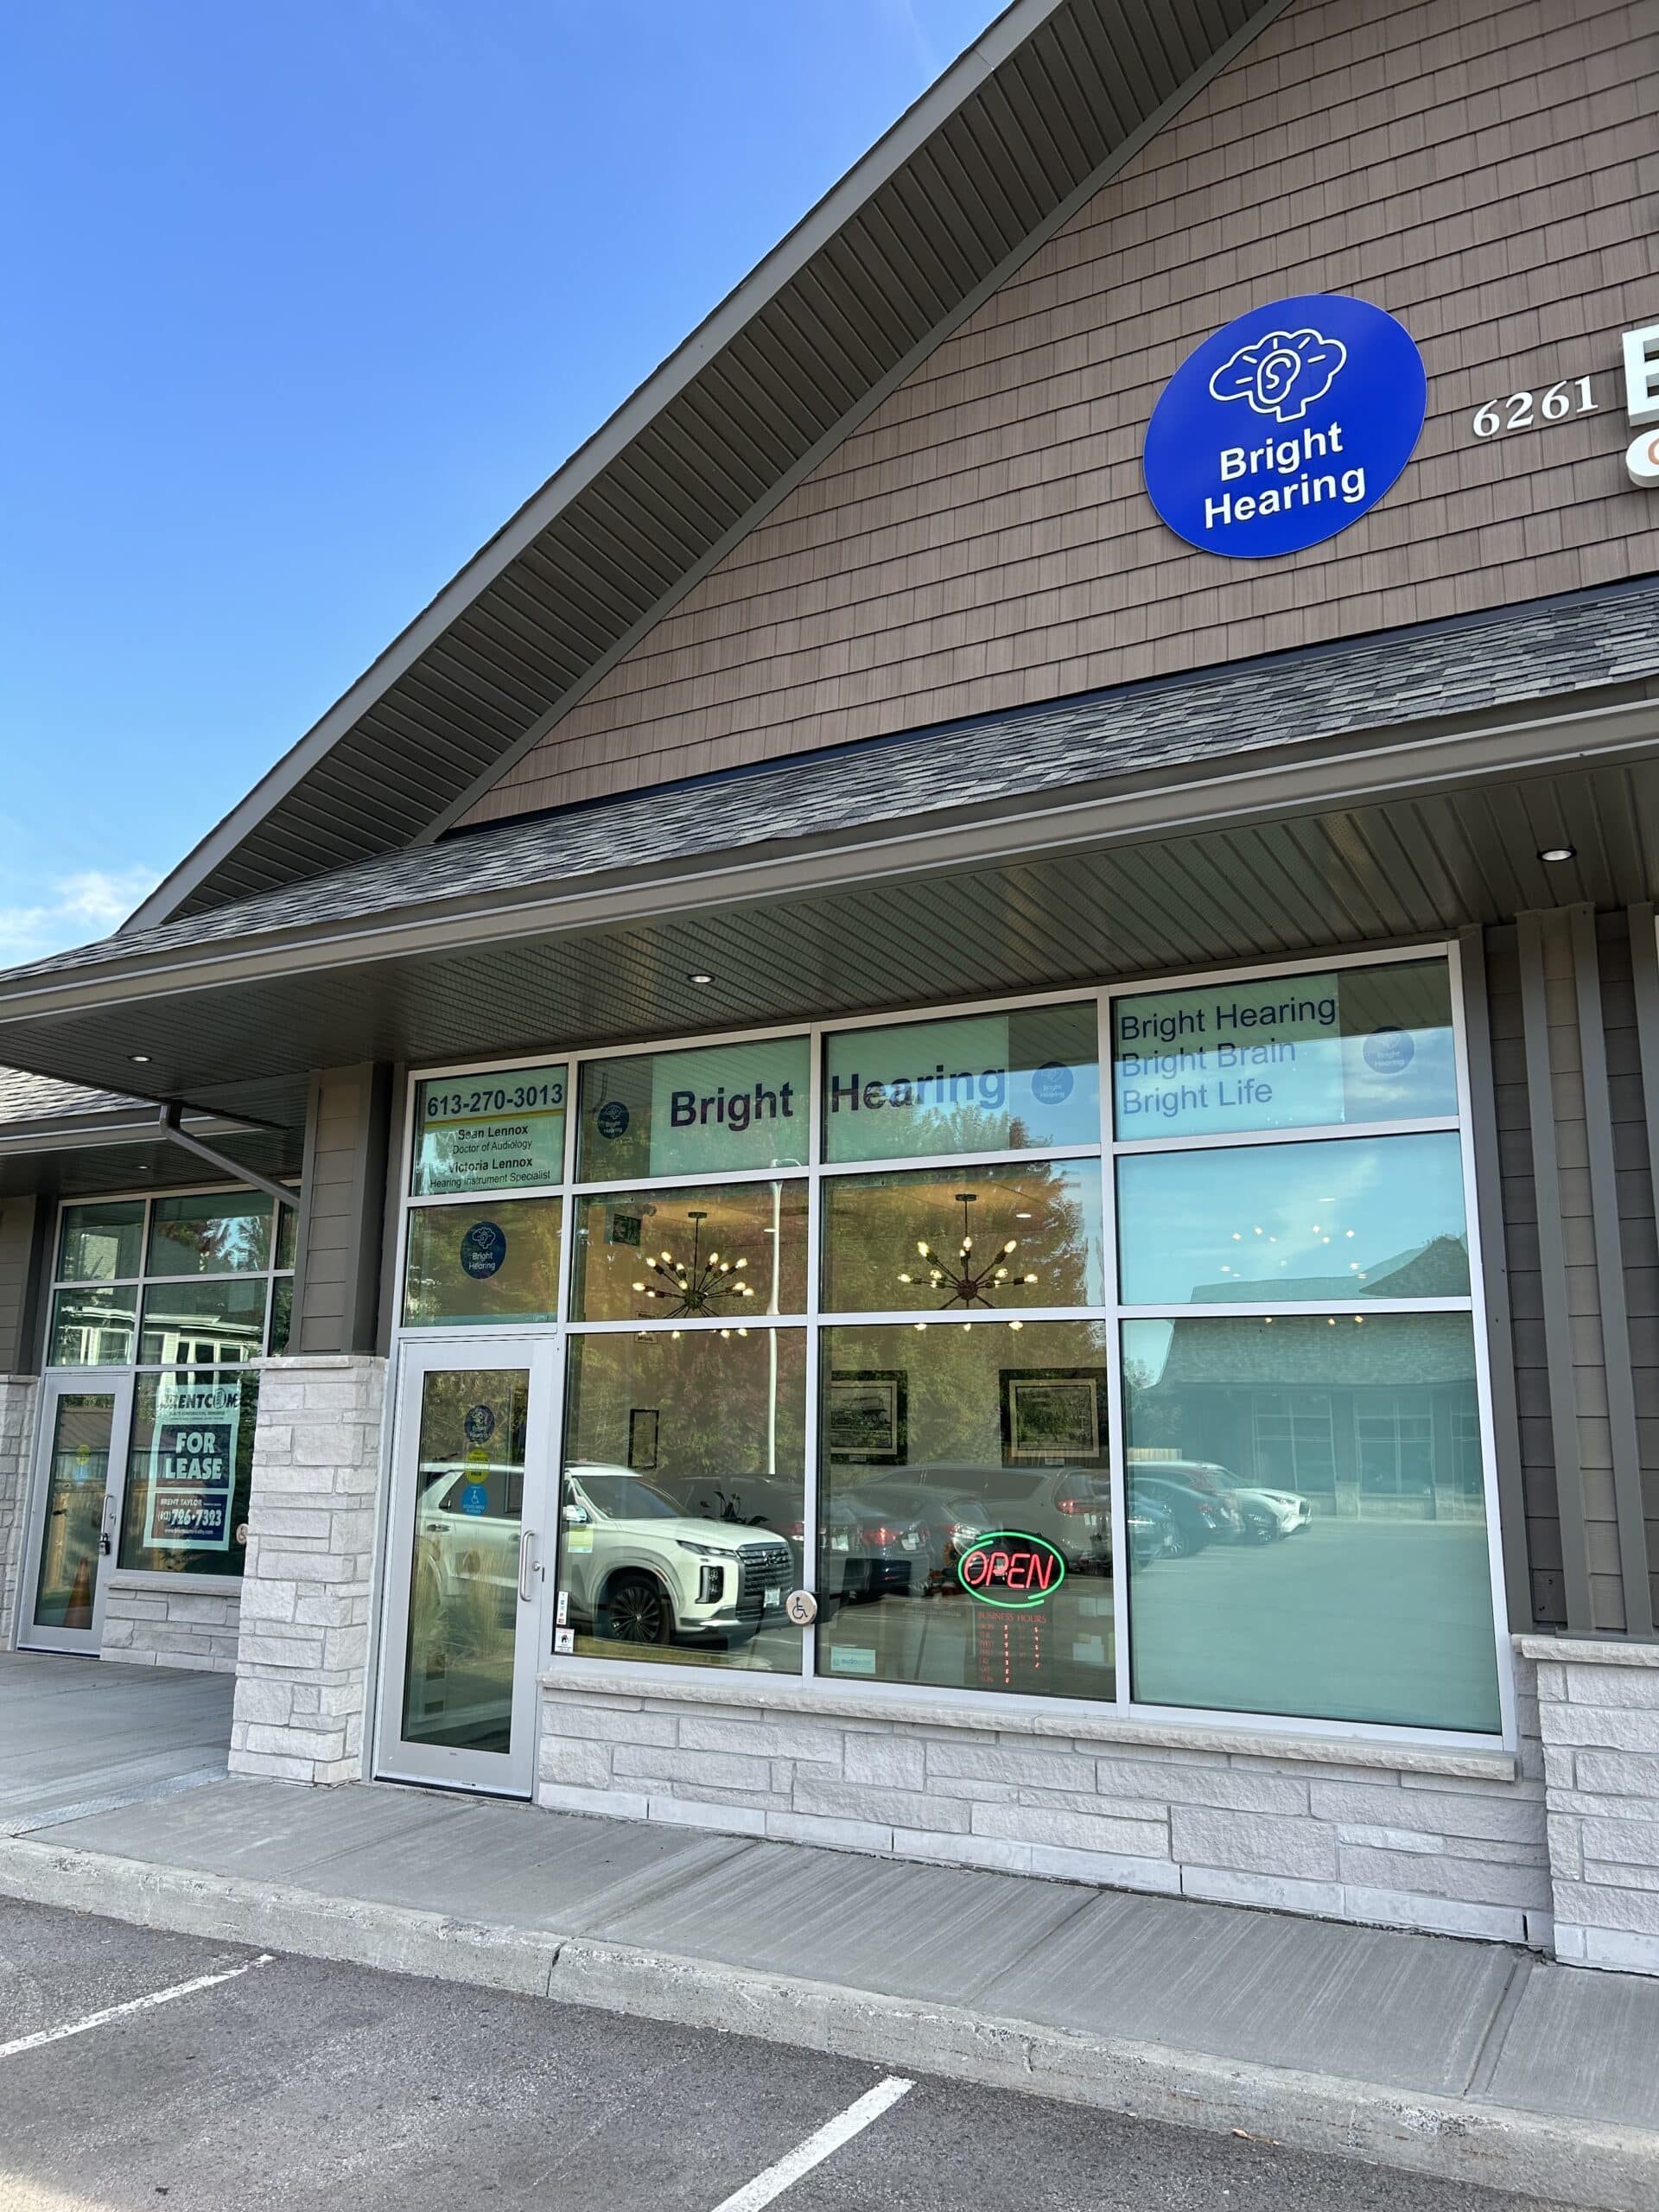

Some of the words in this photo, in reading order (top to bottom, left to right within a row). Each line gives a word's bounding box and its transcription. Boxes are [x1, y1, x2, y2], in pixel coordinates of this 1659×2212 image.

[1472, 375, 1599, 438] 6261
[1219, 422, 1344, 483] Bright
[1204, 467, 1367, 529] Hearing
[1122, 1008, 1205, 1042] Bright
[1216, 996, 1336, 1030] Hearing
[1122, 1046, 1207, 1079] Bright
[1217, 1038, 1296, 1068] Brain
[427, 1083, 563, 1116] 613-270-3013
[670, 1081, 794, 1132] Bright
[830, 1065, 1007, 1113] Hearing
[1123, 1085, 1208, 1117] Bright
[1218, 1078, 1273, 1107] Life
[452, 1144, 479, 1154] Doctor
[481, 1142, 490, 1152] of
[492, 1139, 533, 1151] Audiology
[458, 1128, 485, 1141] Sean
[487, 1126, 529, 1138] Lennox
[430, 1178, 461, 1188] Hearing
[463, 1174, 508, 1185] Instrument
[510, 1170, 550, 1182] Specialist
[449, 1160, 489, 1173] Victoria
[492, 1158, 533, 1170] Lennox
[468, 1262, 496, 1271] Hearing
[472, 1252, 493, 1262] Bright
[175, 1431, 216, 1454] FOR
[165, 1457, 223, 1480] LEASE
[180, 1498, 202, 1507] TAYLOR
[963, 1550, 1054, 1590] OPEN
